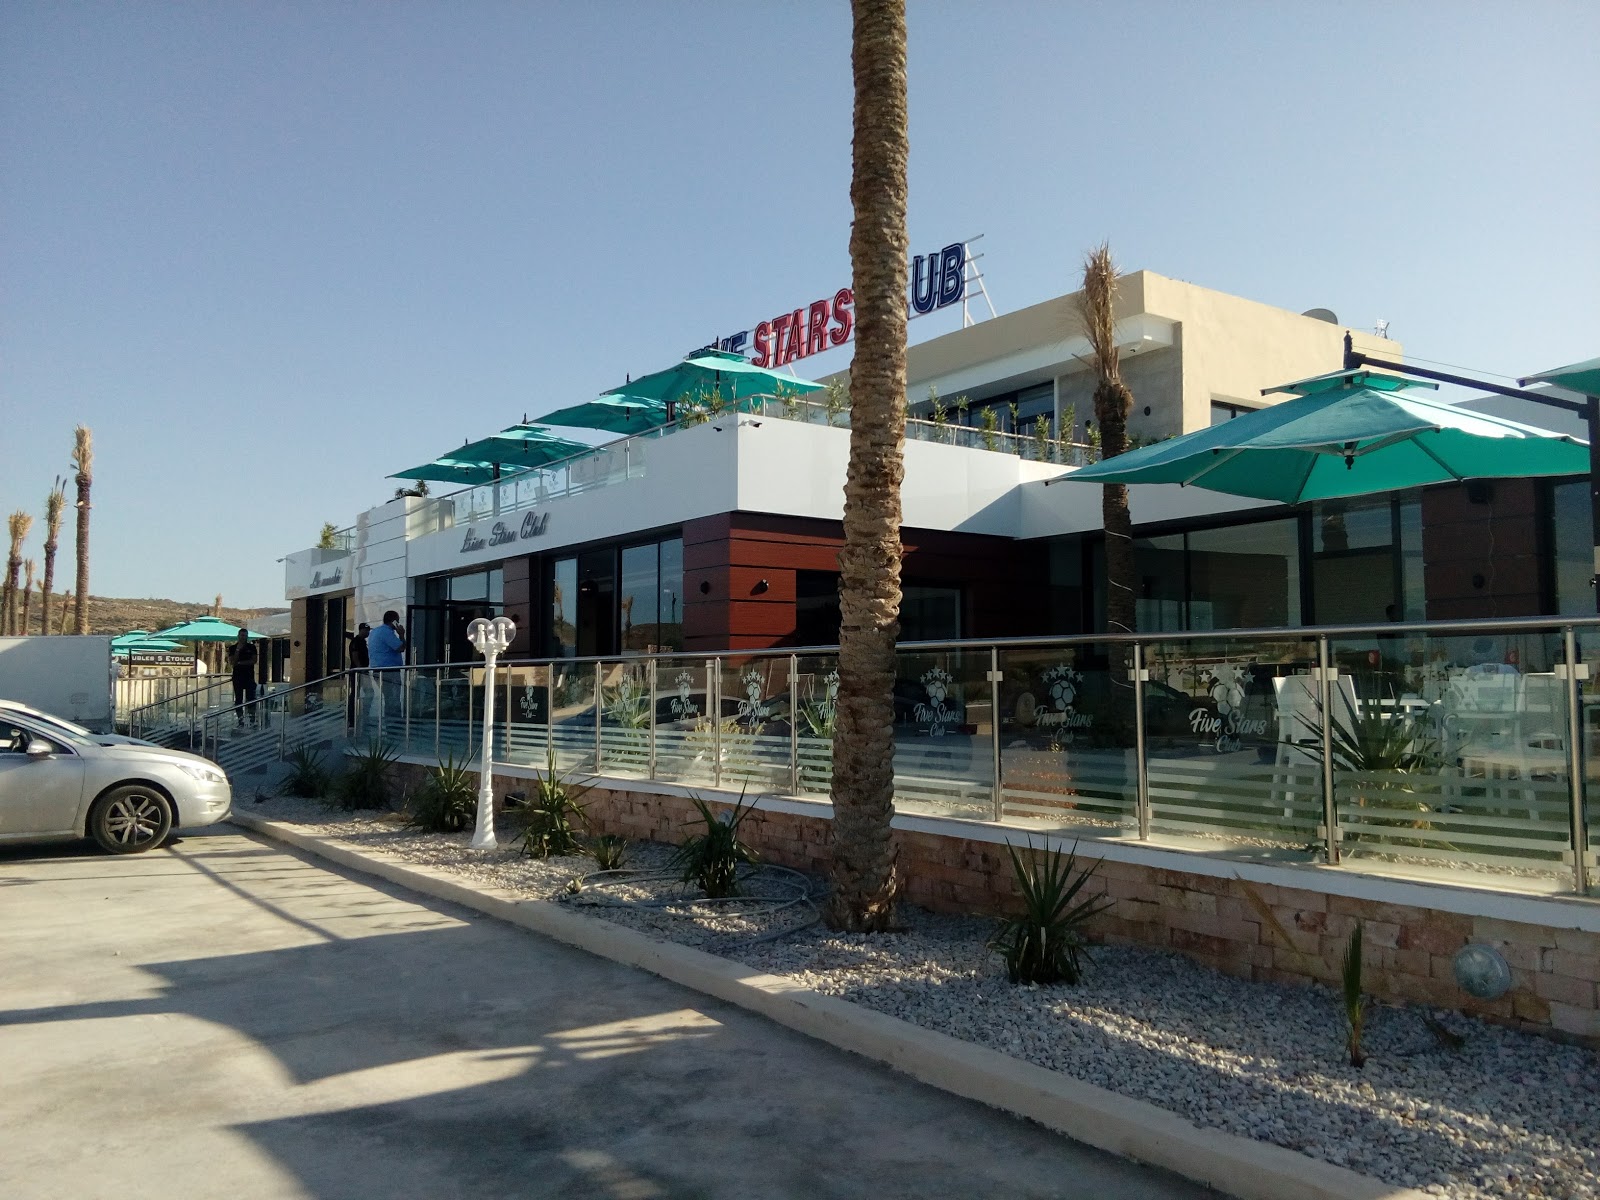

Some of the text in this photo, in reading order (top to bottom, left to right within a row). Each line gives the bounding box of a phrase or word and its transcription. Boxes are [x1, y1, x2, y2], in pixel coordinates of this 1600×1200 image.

[752, 287, 855, 369] STARS
[911, 243, 966, 316] UB
[913, 702, 961, 724] Five Stars
[1033, 704, 1095, 728] Five Stars
[1188, 707, 1267, 735] Five Stars
[929, 723, 945, 738] Club
[1055, 727, 1075, 744] Club
[1216, 734, 1241, 753] Club
